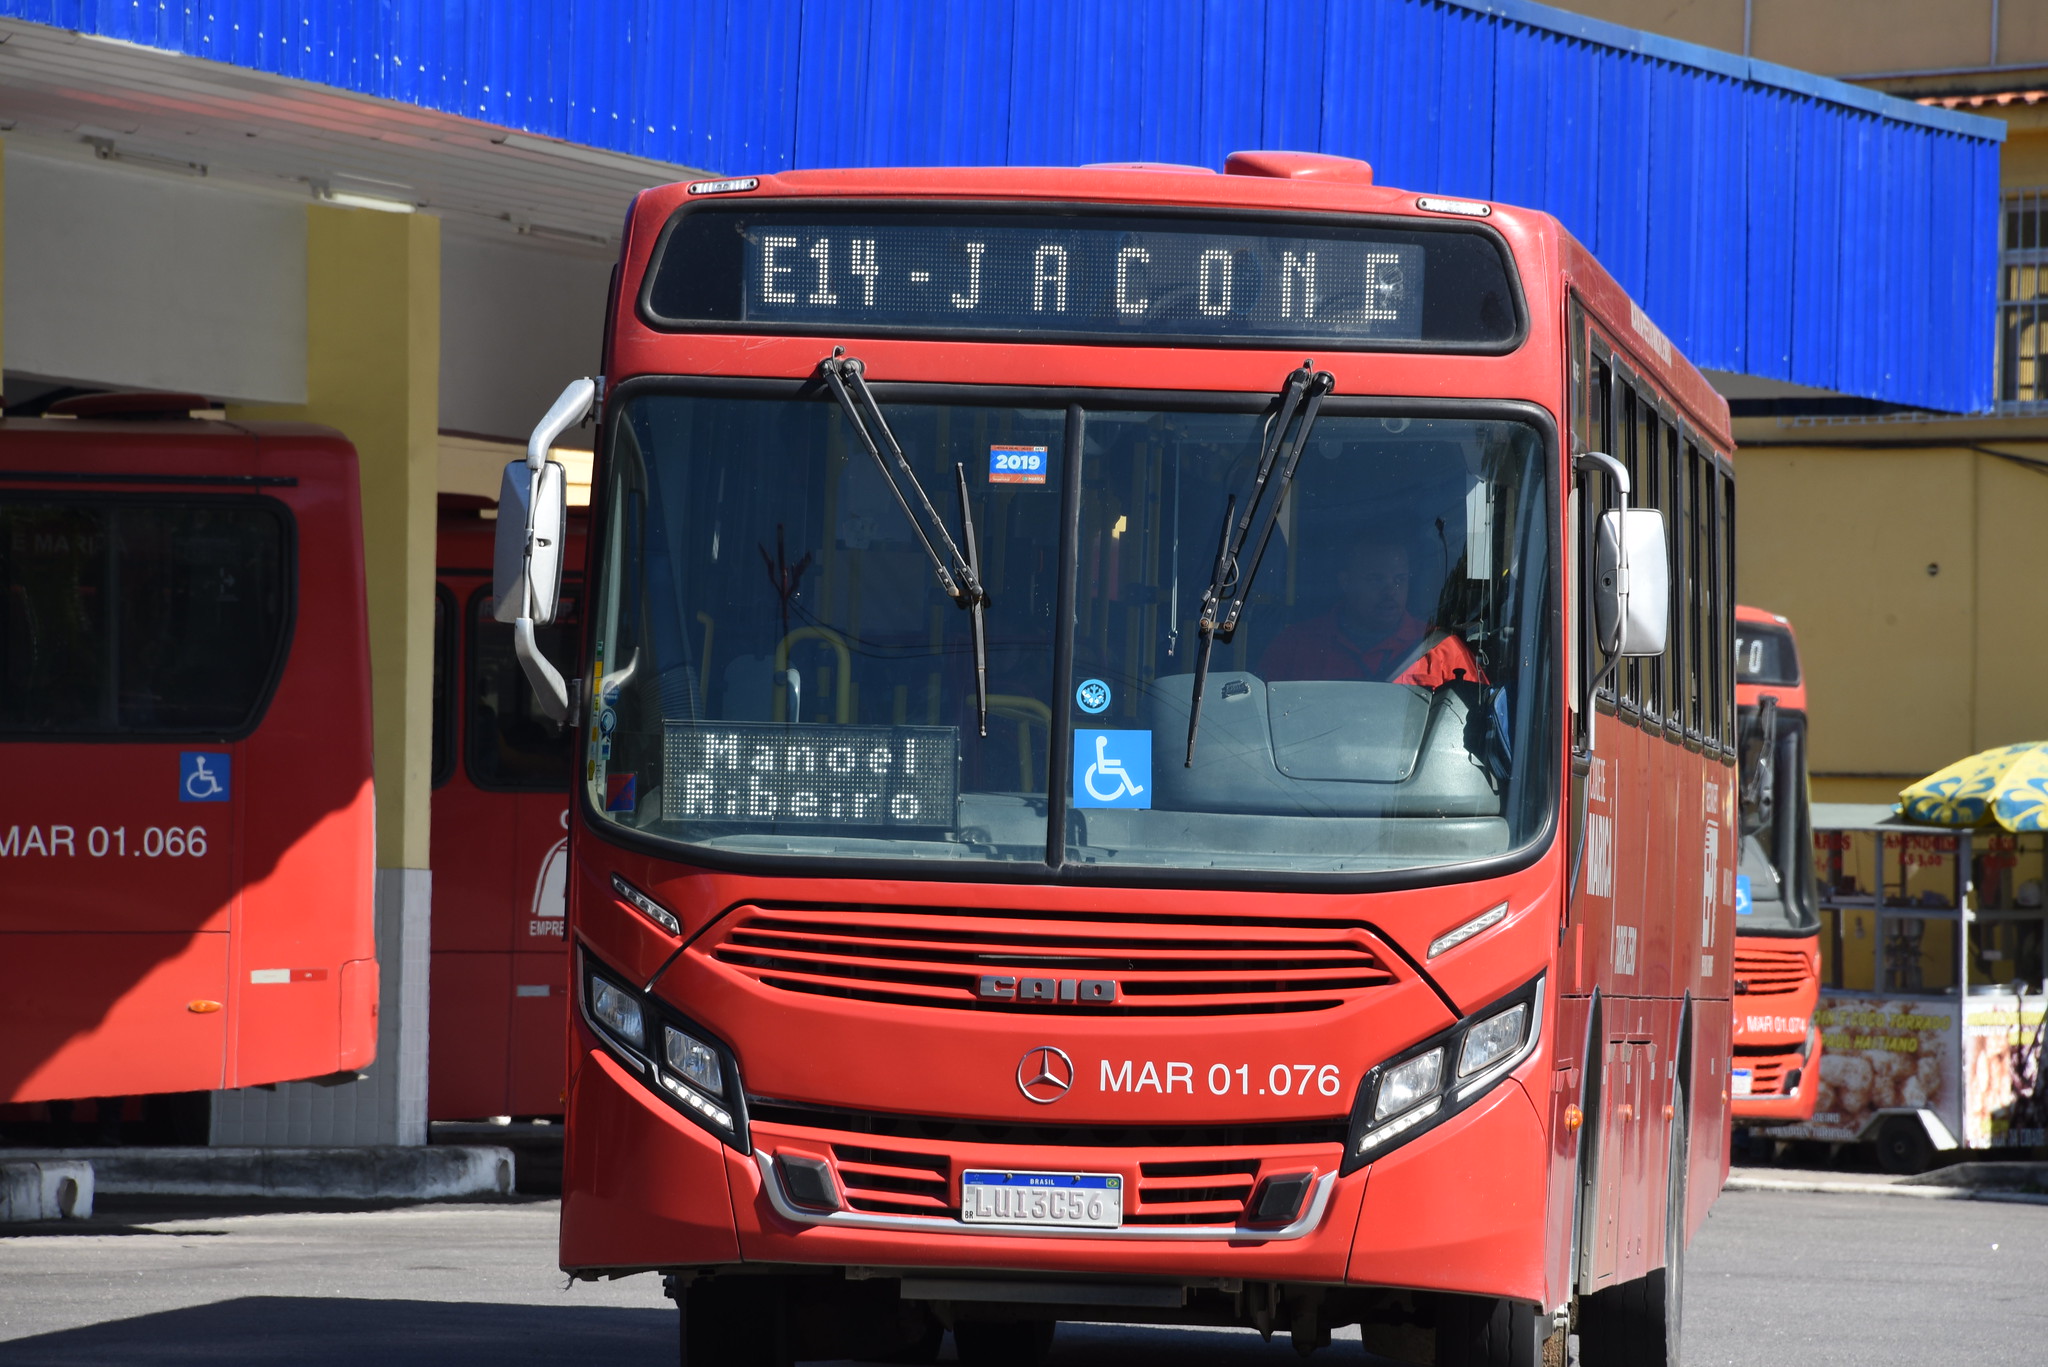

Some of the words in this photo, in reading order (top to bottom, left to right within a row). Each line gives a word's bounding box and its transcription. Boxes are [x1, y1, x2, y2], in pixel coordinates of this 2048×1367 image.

[995, 454, 1041, 470] 2019
[705, 734, 916, 774] Manoel
[686, 774, 919, 819] Ribeiro
[0, 825, 76, 857] MAR
[87, 825, 208, 858] 01.066
[979, 974, 1117, 1001] CAIO
[1746, 1015, 1773, 1033] MAR
[1099, 1059, 1195, 1095] MAR
[1207, 1062, 1341, 1097] 01.076
[1029, 1178, 1055, 1186] BRASIL
[964, 1210, 974, 1220] BR
